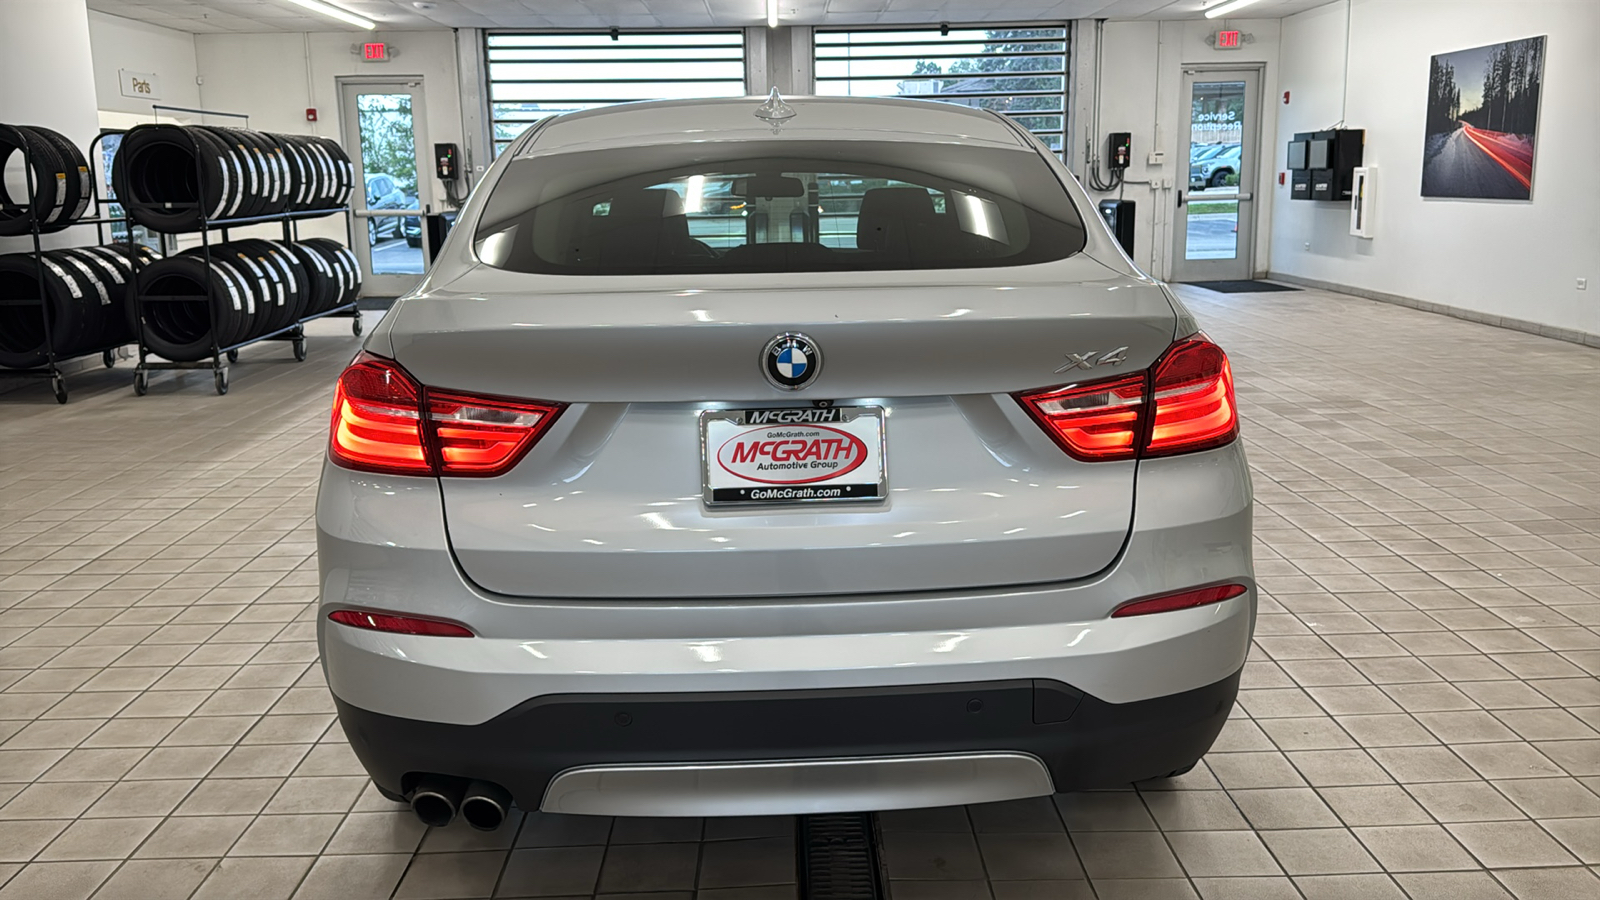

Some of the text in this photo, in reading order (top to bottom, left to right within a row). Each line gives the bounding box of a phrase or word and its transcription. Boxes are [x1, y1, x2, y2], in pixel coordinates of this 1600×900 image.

[1219, 30, 1239, 47] EXIT
[364, 42, 385, 59] EXIT
[132, 77, 151, 94] Parts
[771, 339, 813, 357] BMW
[1053, 345, 1129, 374] X4
[766, 430, 820, 439] GoMcGrath.com
[756, 460, 839, 471] Automotive Group
[750, 488, 841, 500] GoMcGrath.com
